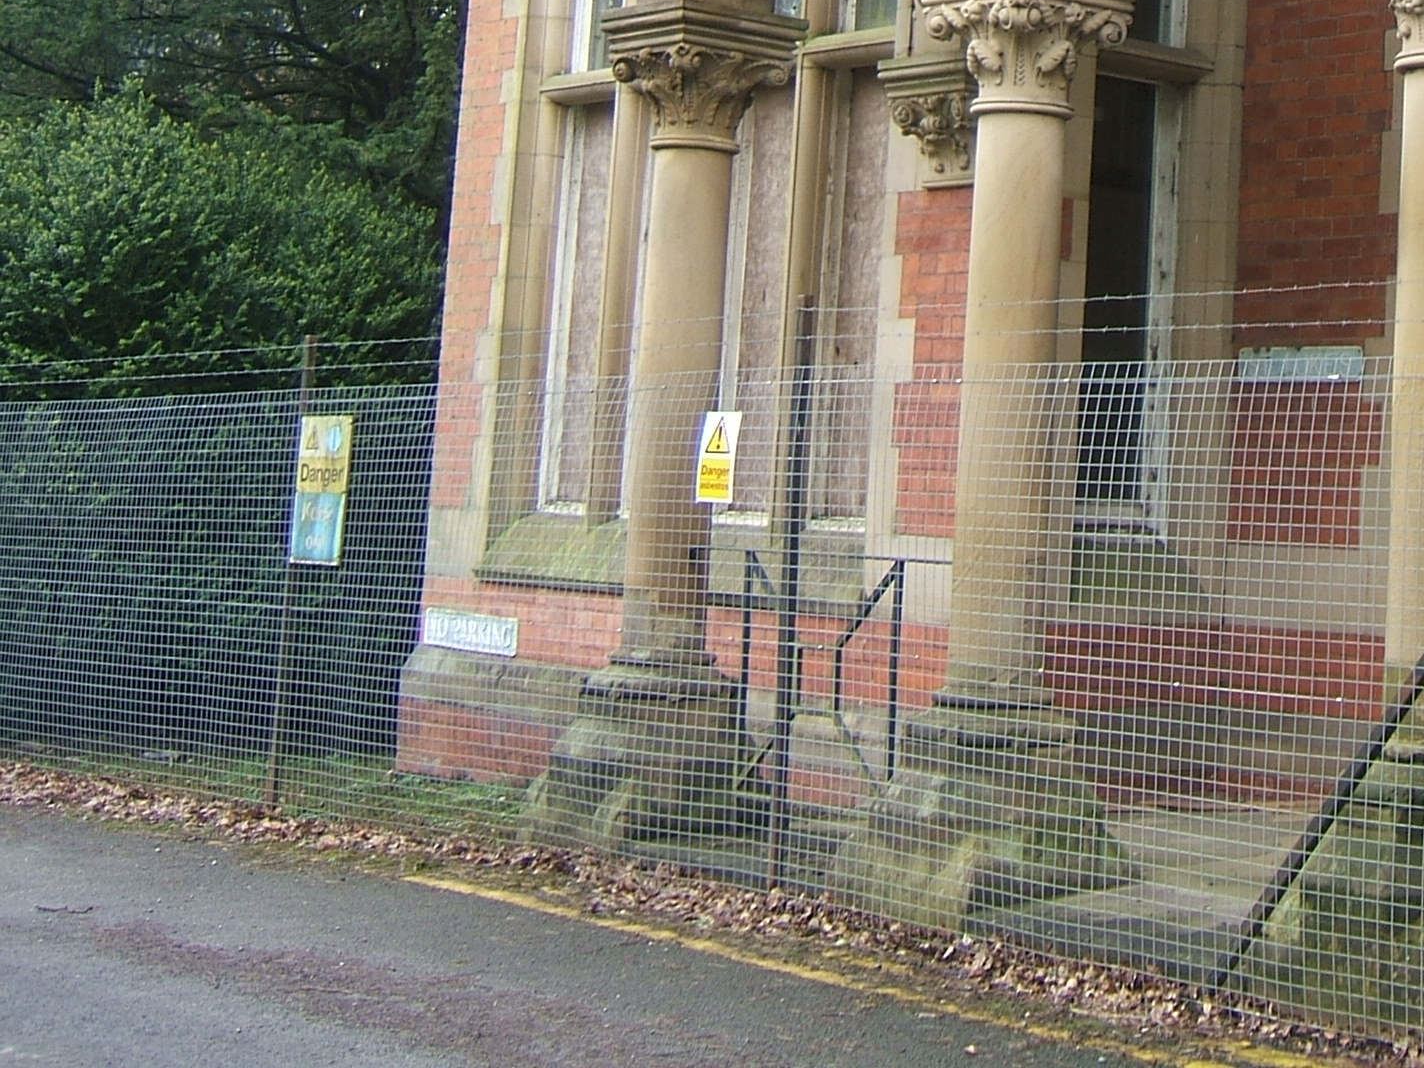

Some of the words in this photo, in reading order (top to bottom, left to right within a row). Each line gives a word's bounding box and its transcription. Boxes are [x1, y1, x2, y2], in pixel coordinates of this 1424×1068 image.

[301, 463, 344, 487] Danger
[701, 465, 730, 479] Danger
[700, 482, 729, 491] asbestos
[428, 617, 448, 639] NO
[453, 618, 512, 649] PARKING
